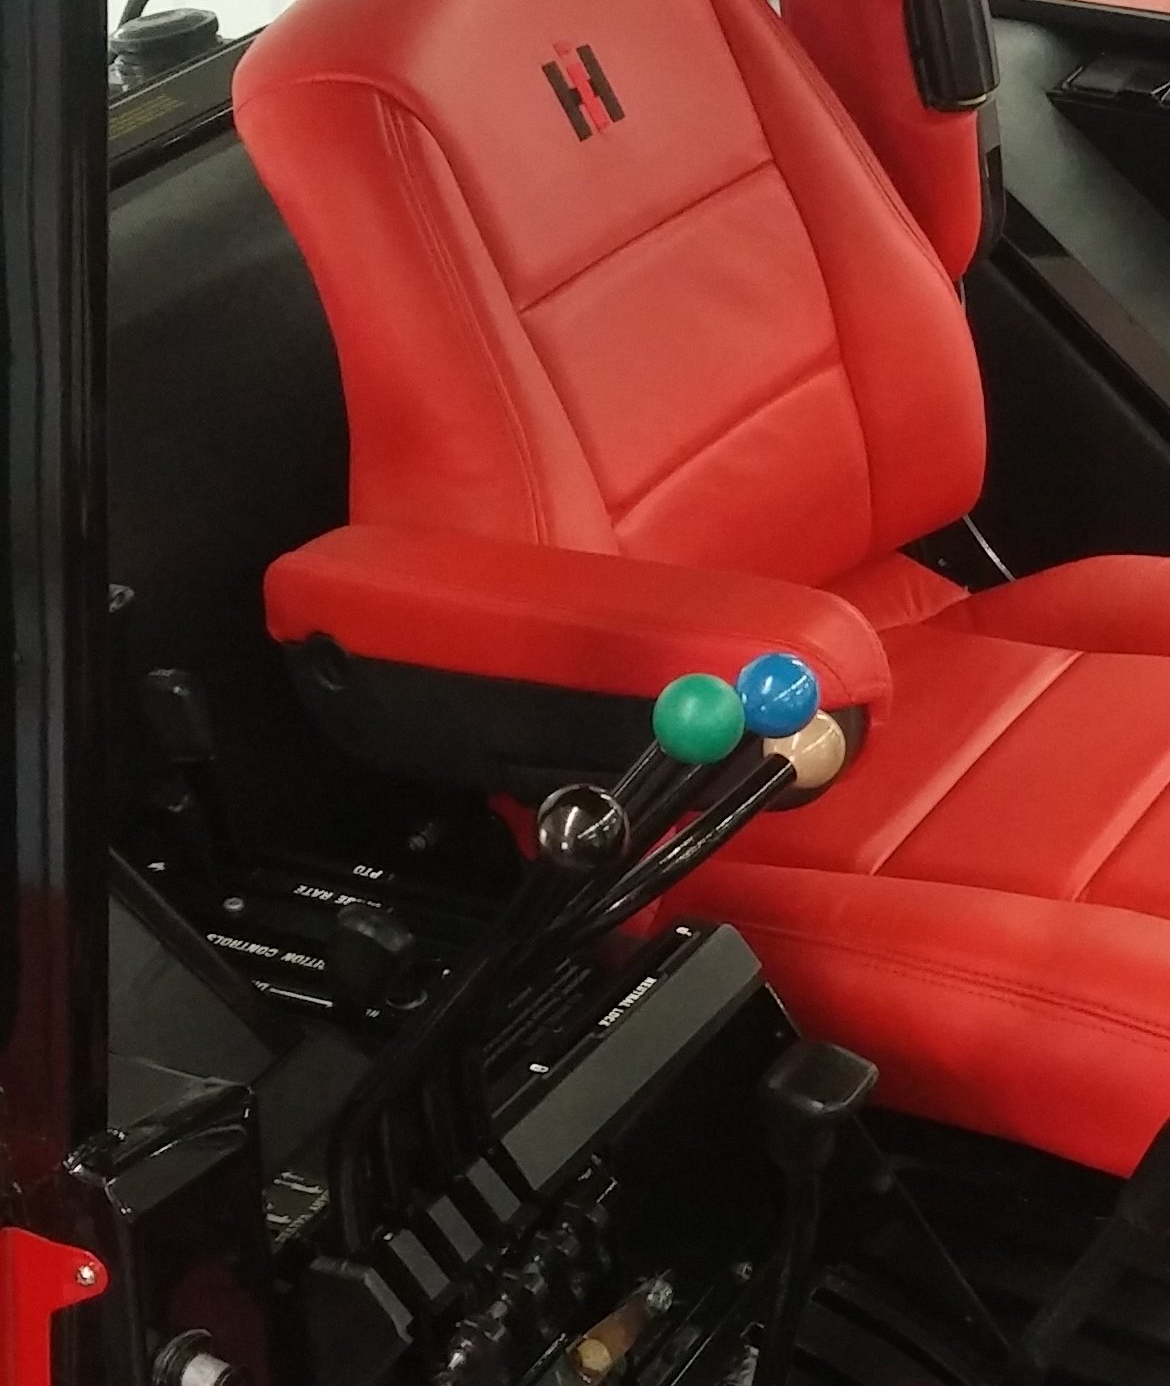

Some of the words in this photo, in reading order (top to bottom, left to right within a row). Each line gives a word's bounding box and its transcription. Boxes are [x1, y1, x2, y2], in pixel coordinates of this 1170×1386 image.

[353, 865, 384, 880] PTO
[293, 884, 334, 901] RATE
[618, 976, 657, 1008] NEUTRAL
[598, 1007, 624, 1027] LOCK
